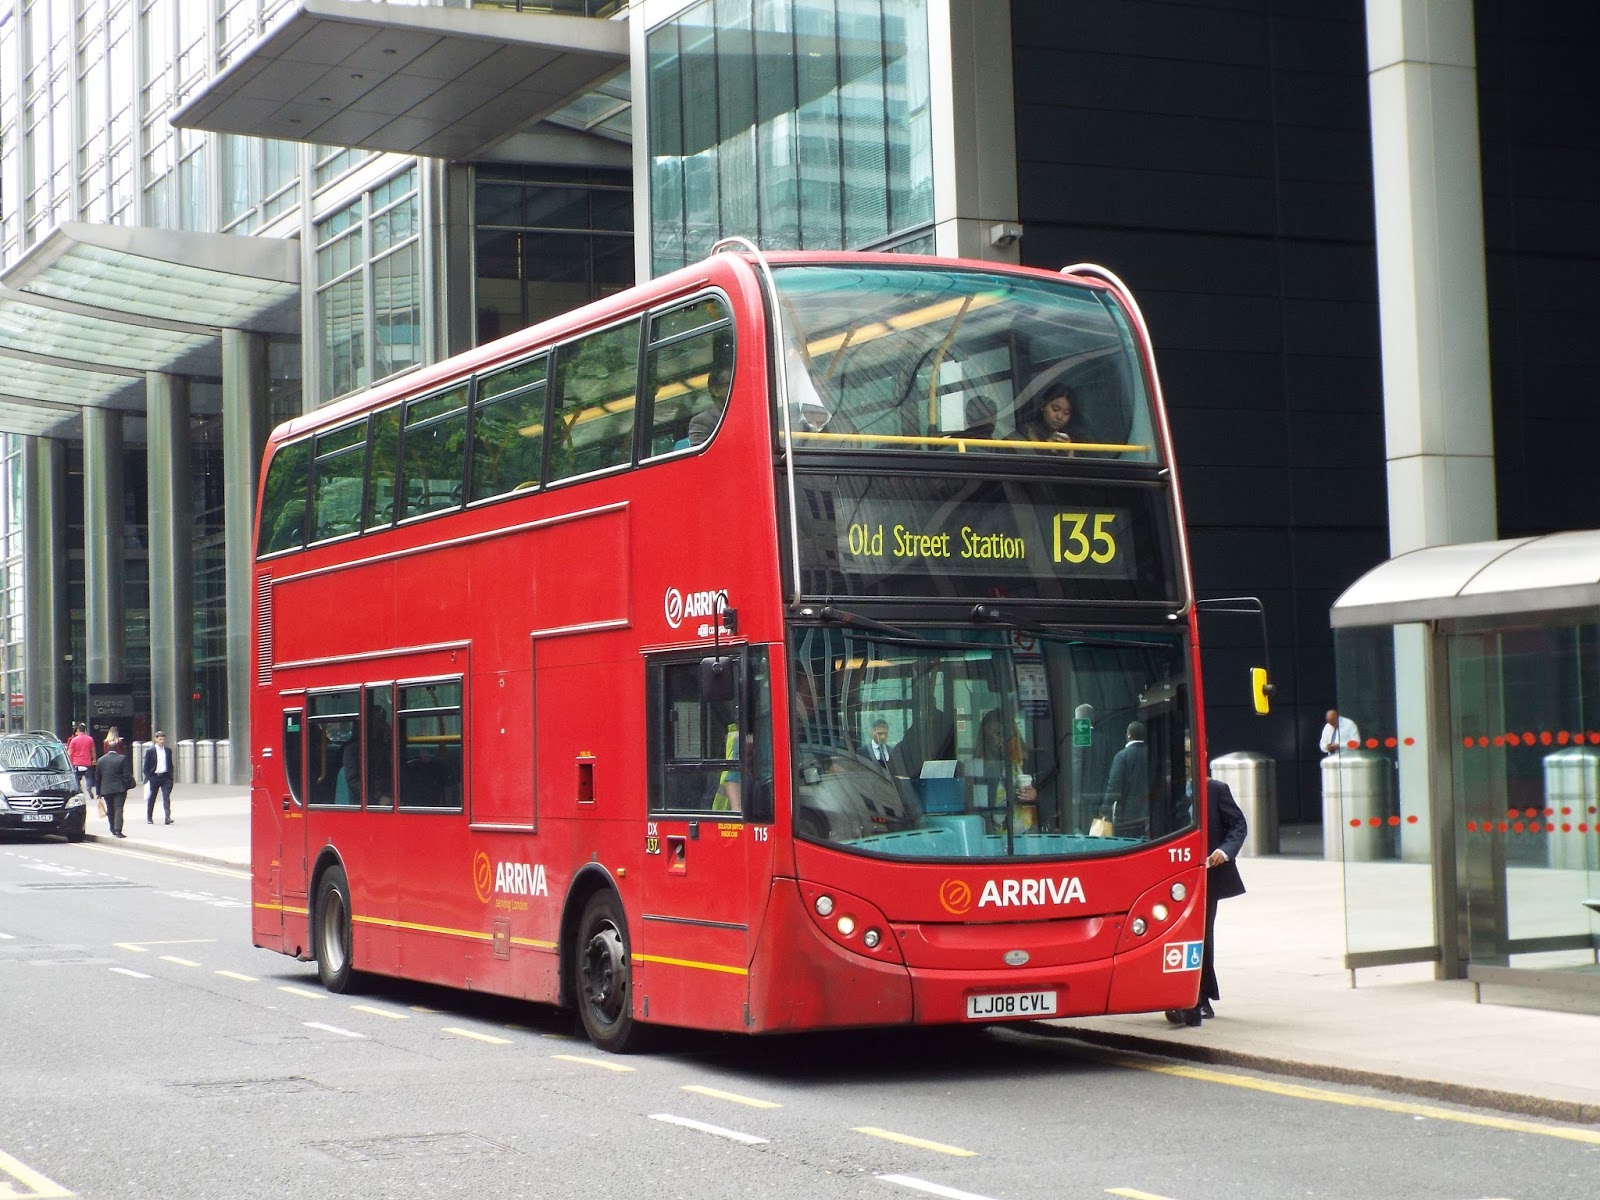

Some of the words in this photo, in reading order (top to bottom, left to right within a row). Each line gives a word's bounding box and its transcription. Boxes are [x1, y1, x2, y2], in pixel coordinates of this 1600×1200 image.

[848, 523, 883, 556] Old
[893, 524, 950, 559] Street
[960, 526, 1025, 560] Station
[1053, 512, 1117, 564] 135
[647, 822, 658, 836] DX
[753, 826, 768, 842] T15
[647, 838, 658, 852] 137
[1168, 848, 1191, 863] T15
[494, 861, 548, 897] ARRIVA
[977, 876, 1087, 907] ARRIVA
[495, 898, 511, 912] serving
[511, 900, 529, 911] London
[972, 995, 1015, 1015] LJ08
[1019, 994, 1050, 1012] CVL
